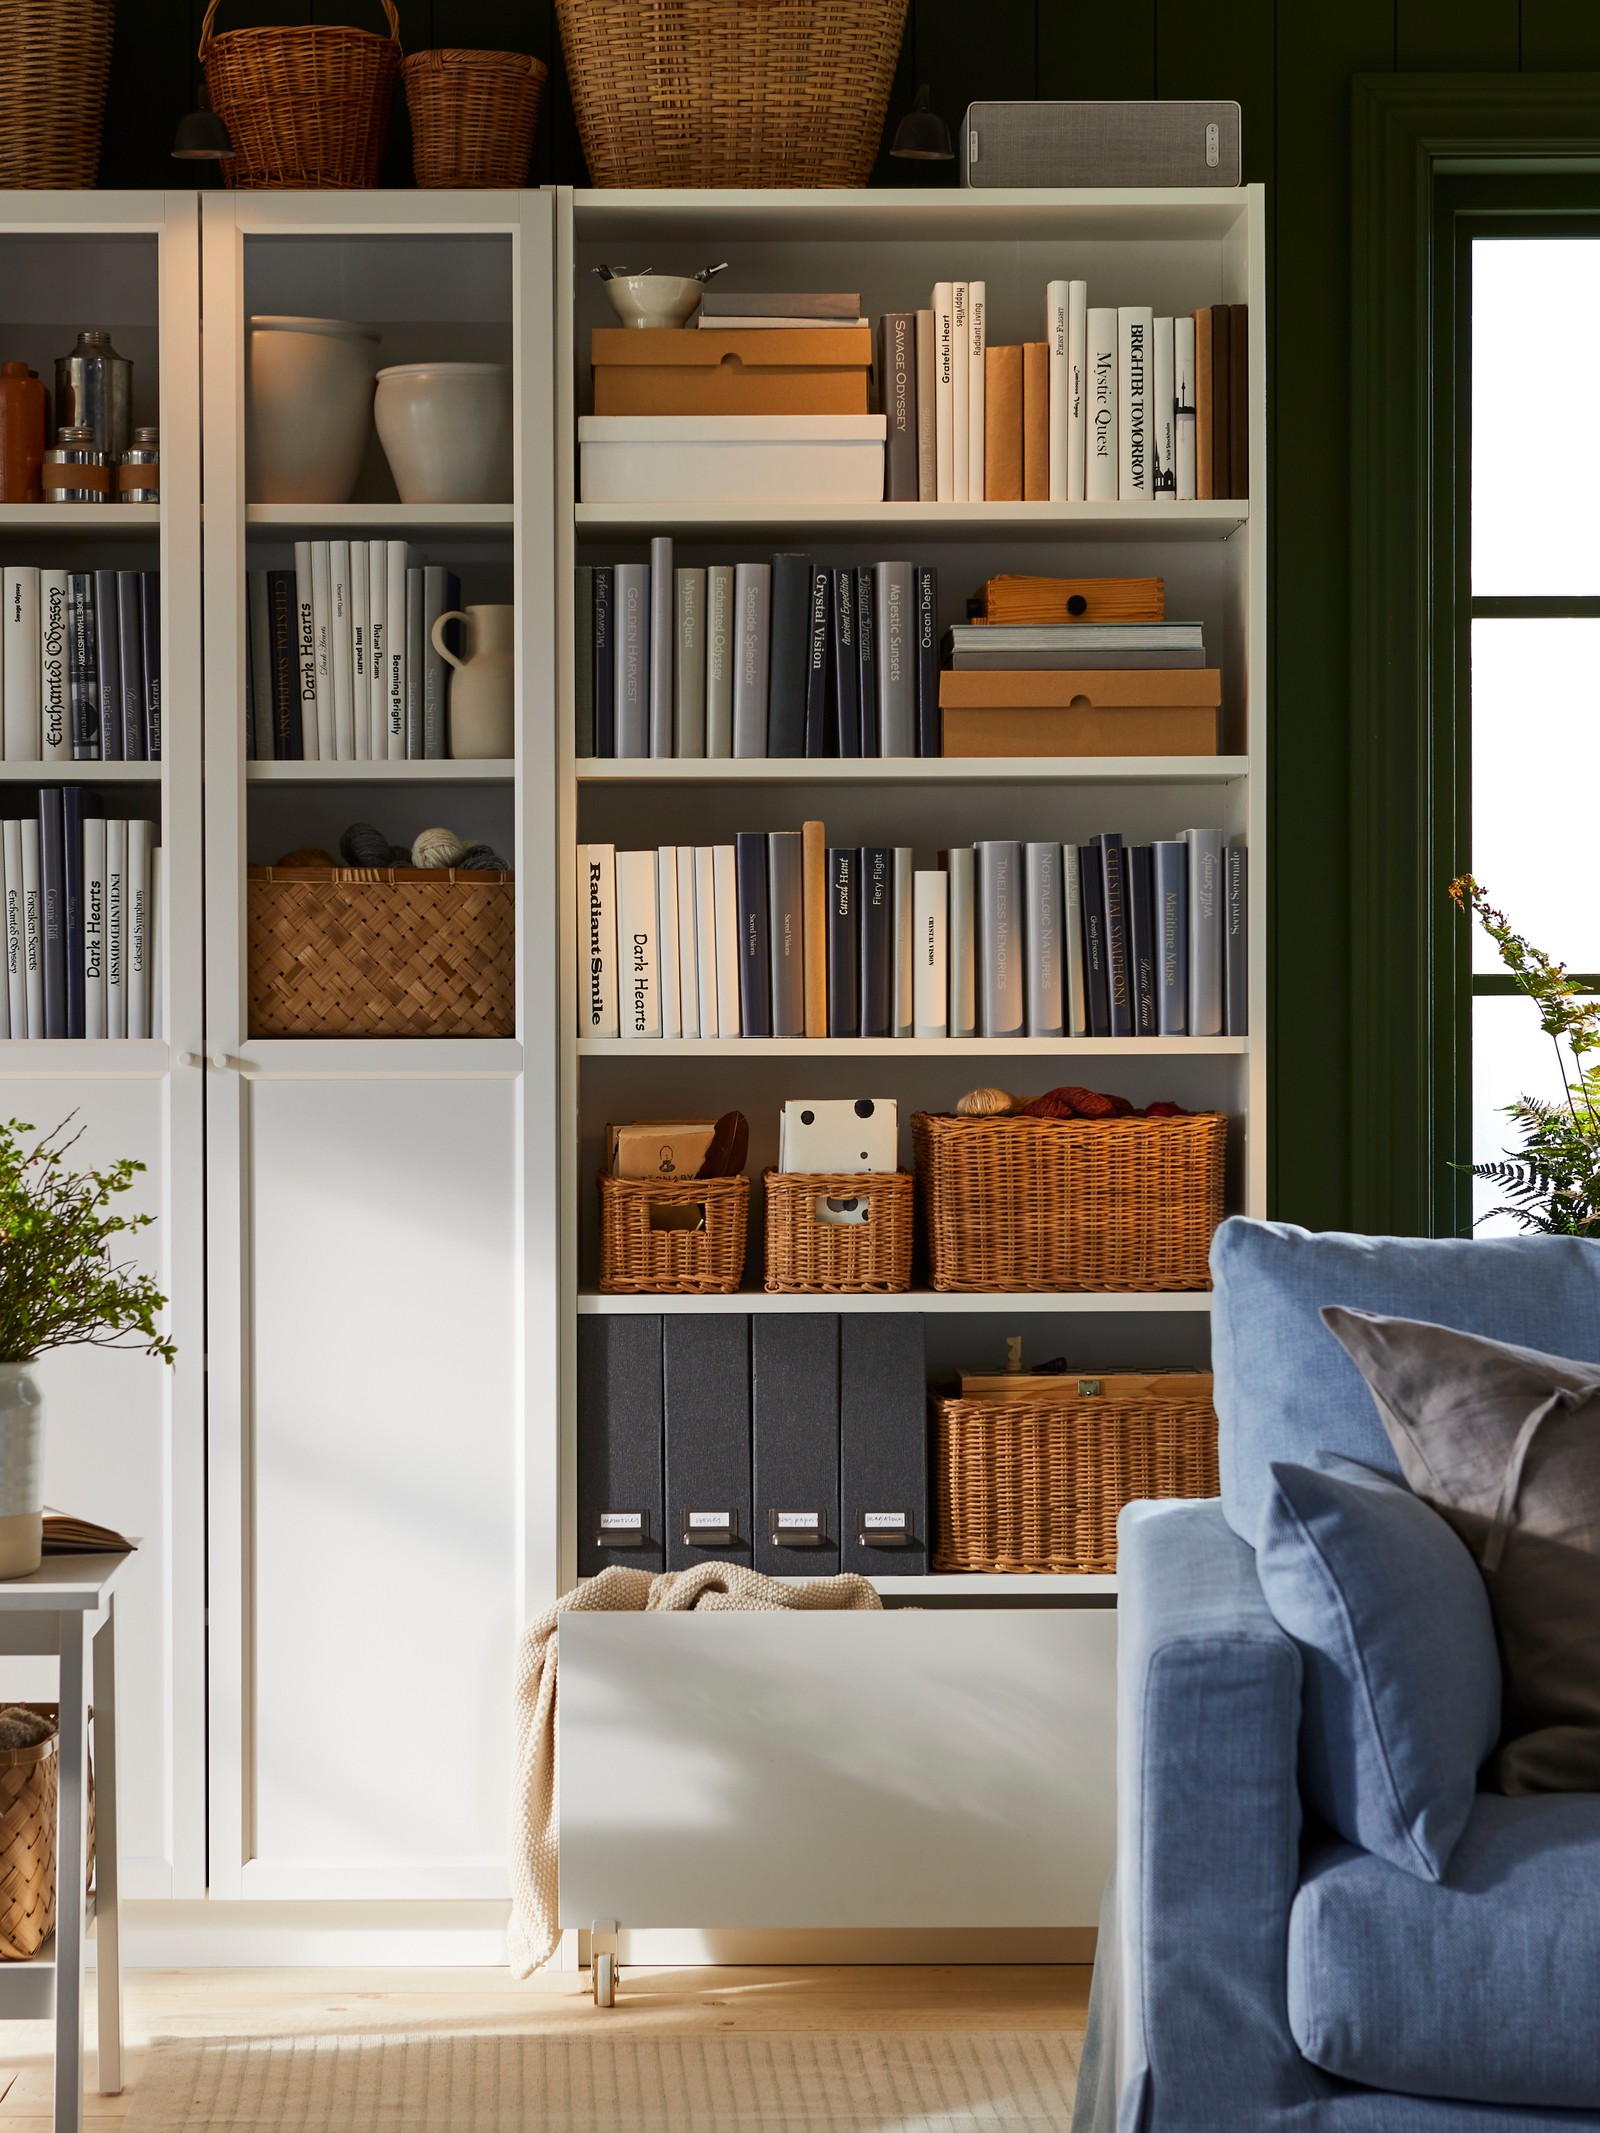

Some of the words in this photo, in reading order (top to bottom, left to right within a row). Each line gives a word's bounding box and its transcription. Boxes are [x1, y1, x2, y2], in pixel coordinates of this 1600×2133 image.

[942, 315, 950, 342] Heart
[974, 303, 983, 326] Living
[895, 320, 906, 369] SAVAGE
[974, 328, 982, 356] Radiant
[1131, 324, 1144, 396] BRIGHTER
[941, 348, 950, 384] Grateful
[1094, 352, 1112, 403] Mystic
[896, 373, 906, 432] ODYSSEY
[1095, 409, 1112, 458] Quest
[1131, 399, 1144, 489] TOMORROW
[76, 593, 84, 615] MORE
[683, 579, 695, 614] Mystic
[715, 577, 726, 631] Enchanted
[747, 587, 758, 631] Seaside
[813, 575, 826, 622] Crystal
[840, 574, 851, 613] Expedition
[860, 575, 870, 614] Distant
[888, 584, 901, 633] Majestic
[921, 574, 931, 610] Depths
[45, 587, 65, 656] Odyssey
[301, 604, 313, 656] Hearts
[627, 588, 638, 641] GOLDEN
[684, 617, 695, 647] Quest
[841, 616, 851, 645] Ancient
[922, 613, 931, 647] Ocean
[78, 636, 86, 665] HISTORY
[374, 624, 382, 649] Distant
[813, 628, 824, 669] Vision
[861, 619, 872, 661] Dreams
[374, 652, 382, 679] Dreams
[391, 655, 401, 695] Beaming
[628, 645, 638, 703] HARVEST
[712, 636, 725, 680] Odyssey
[744, 635, 757, 685] Splendor
[890, 637, 901, 681] Sunsets
[150, 679, 159, 709] Secrets
[303, 662, 315, 700] Dark
[44, 660, 65, 747] Enchanted
[103, 686, 112, 718] Rustic
[391, 698, 401, 735] Brightly
[104, 723, 113, 755] Haven
[150, 713, 160, 751] Forsaken
[839, 858, 848, 883] Hunt
[874, 854, 883, 880] Flight
[1068, 856, 1077, 880] Flight
[1203, 852, 1216, 890] Serenity
[1231, 852, 1240, 899] Serenade
[47, 889, 57, 923] Cosmic
[87, 881, 100, 933] Hearts
[111, 874, 120, 939] ENCHANTED
[873, 883, 882, 904] Fiery
[996, 859, 1007, 919] TIMELESS
[1041, 854, 1052, 925] NOSTALGIC
[1068, 883, 1077, 907] Fiery
[1200, 890, 1213, 918] Wild
[8, 890, 18, 935] Enchanted
[27, 890, 37, 934] Forsaken
[134, 889, 145, 933] Symphony
[590, 862, 602, 955] Radiant
[1090, 916, 1098, 939] Ghostly
[1166, 892, 1177, 948] Maritime
[1231, 904, 1239, 934] Secret
[48, 924, 58, 939] Rift
[9, 937, 19, 973] Odyssey
[28, 937, 38, 970] Secrets
[87, 941, 100, 978] Dark
[111, 941, 120, 986] ODYSSEY
[134, 936, 143, 971] Celestial
[634, 934, 648, 971] Dark
[997, 922, 1007, 990] MEMORIES
[1041, 929, 1052, 988] NATURES
[1091, 940, 1099, 970] Encounter
[1110, 926, 1126, 1007] SYMPHONY
[1166, 952, 1176, 985] Muse
[591, 958, 603, 1025] Smile
[1141, 958, 1150, 991] Rustic
[634, 979, 648, 1031] Hearts
[1142, 995, 1153, 1027] Haven
